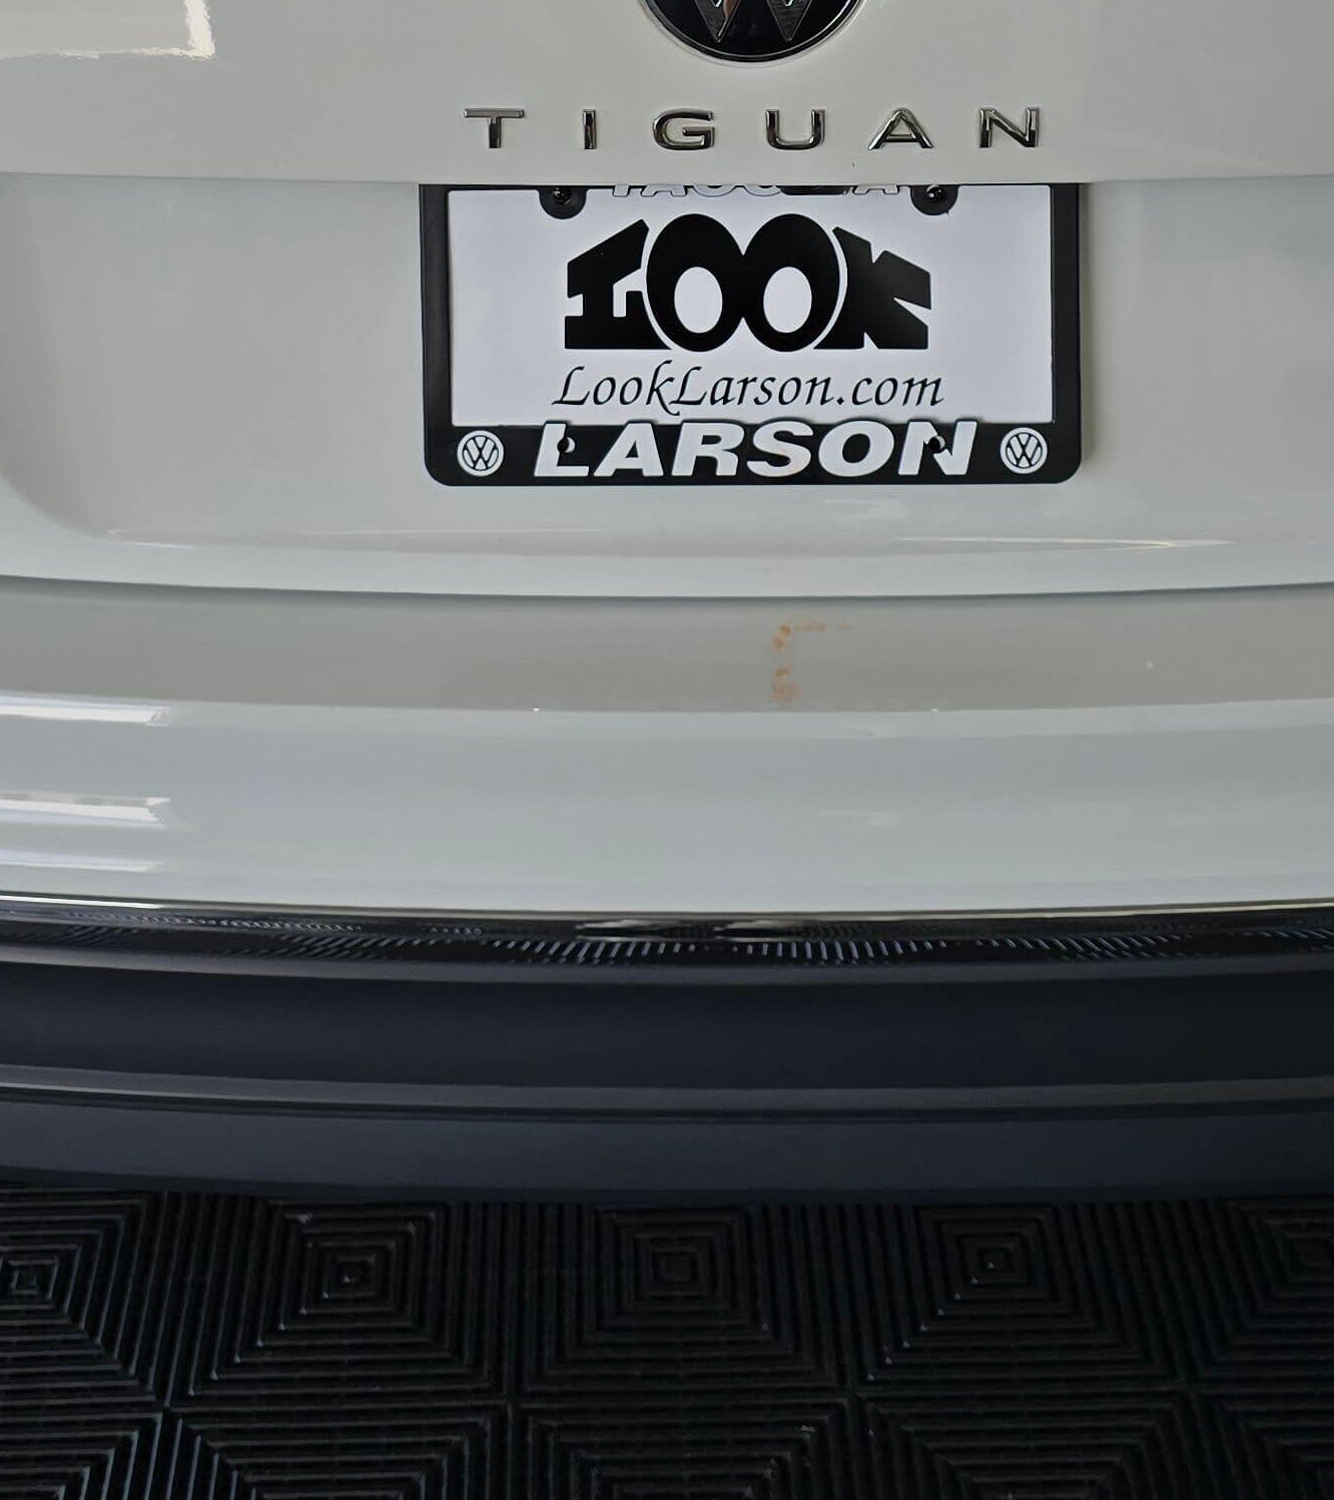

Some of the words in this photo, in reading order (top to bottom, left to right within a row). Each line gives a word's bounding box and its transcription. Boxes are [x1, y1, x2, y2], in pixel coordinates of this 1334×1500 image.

[464, 108, 1040, 150] TIGUAN
[551, 359, 945, 416] LookLarson.com
[533, 420, 978, 477] LARSON
